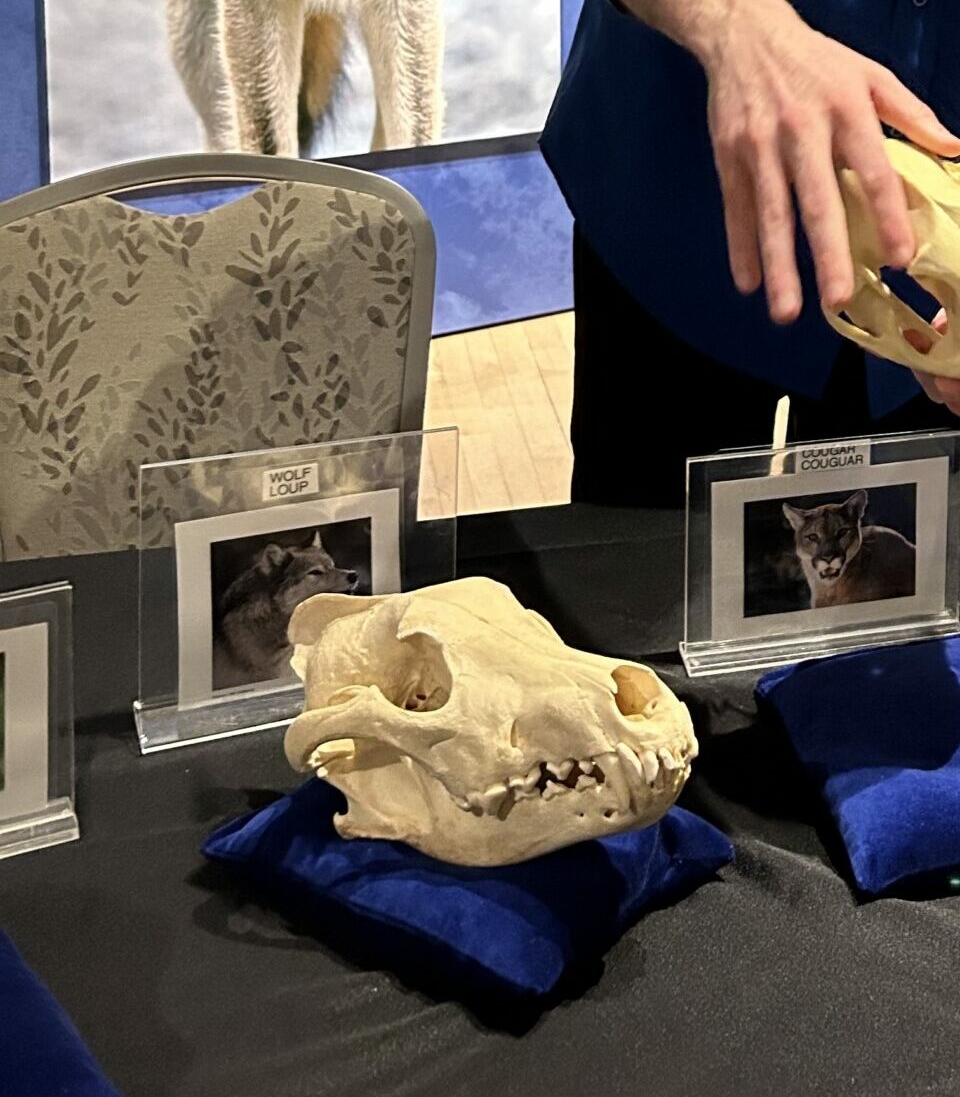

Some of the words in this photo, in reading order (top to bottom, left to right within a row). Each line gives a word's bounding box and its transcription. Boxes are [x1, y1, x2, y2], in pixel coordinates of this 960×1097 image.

[801, 455, 864, 471] COUGUAR
[270, 467, 313, 483] WOLF
[269, 481, 309, 497] LOUP
